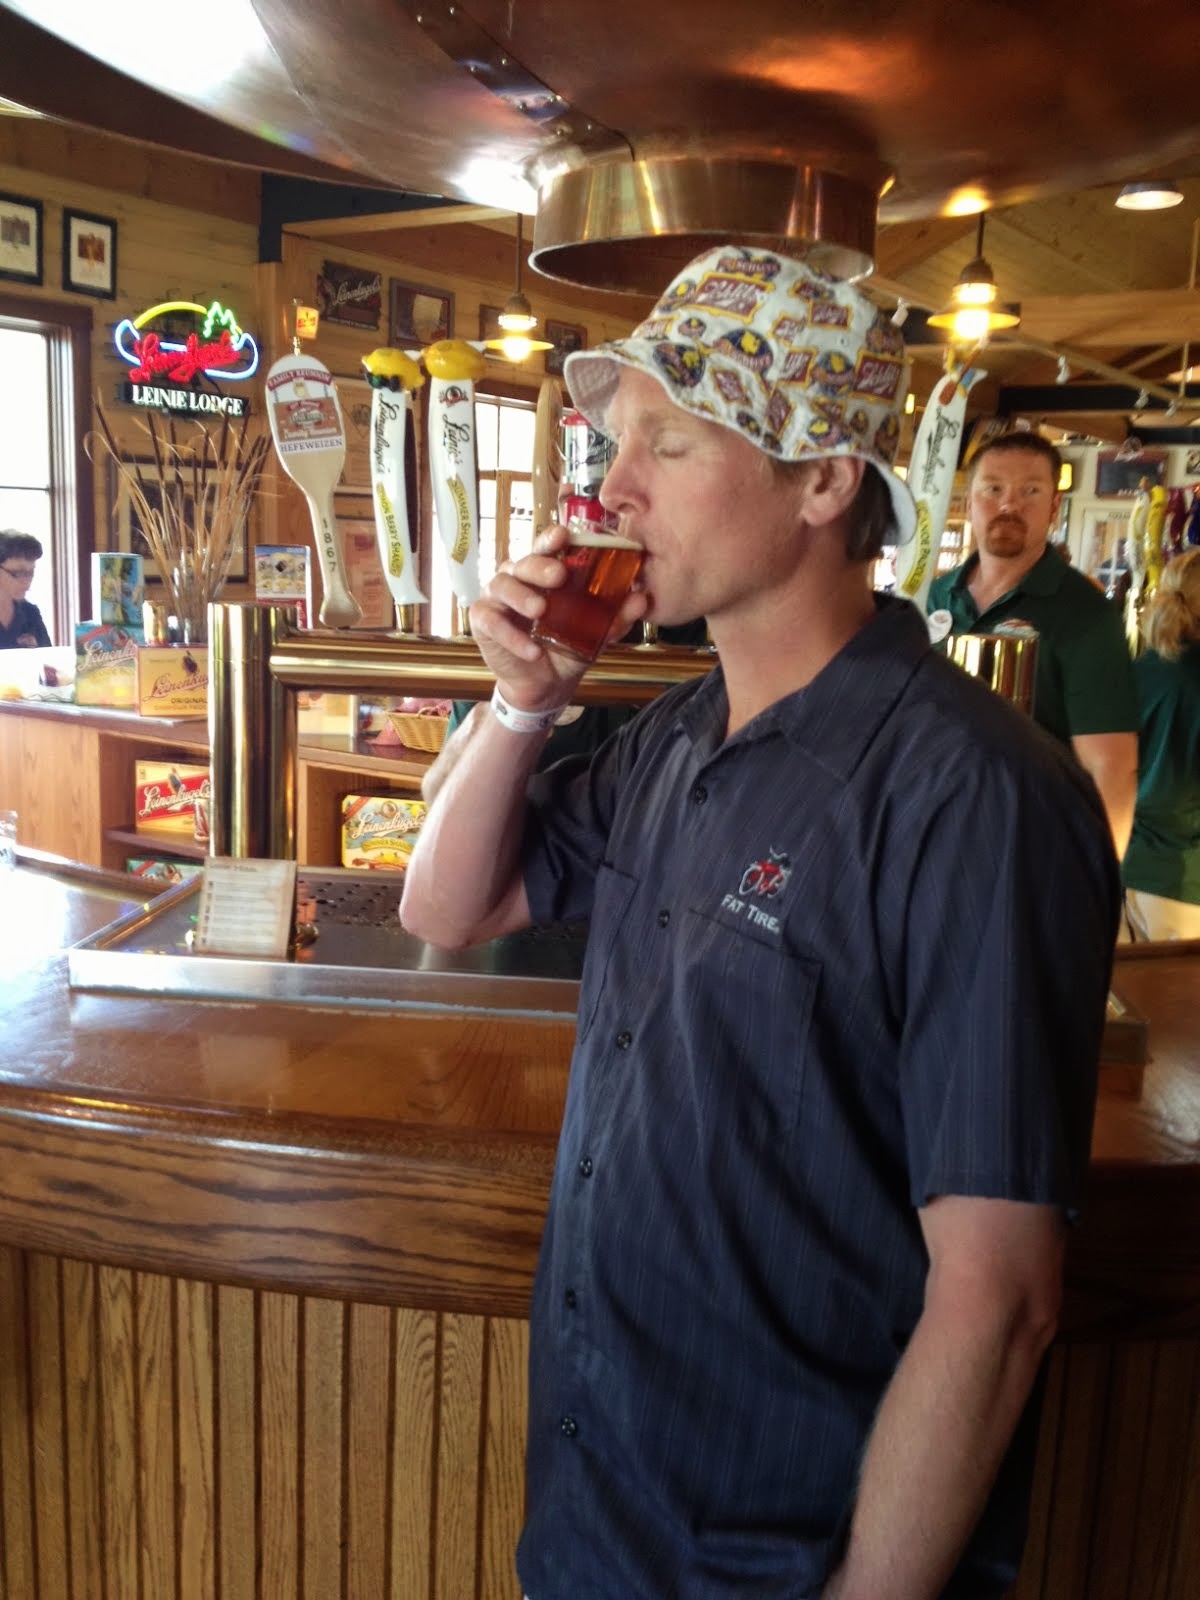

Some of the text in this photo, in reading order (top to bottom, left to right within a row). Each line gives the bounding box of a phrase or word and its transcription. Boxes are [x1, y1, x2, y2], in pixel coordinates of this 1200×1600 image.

[132, 384, 244, 416] LEINIE LODGE
[280, 438, 343, 452] HEFEWEIZEN
[451, 481, 470, 521] SUMMER
[385, 515, 399, 541] BERRY
[720, 893, 780, 934] FAT TIRE
